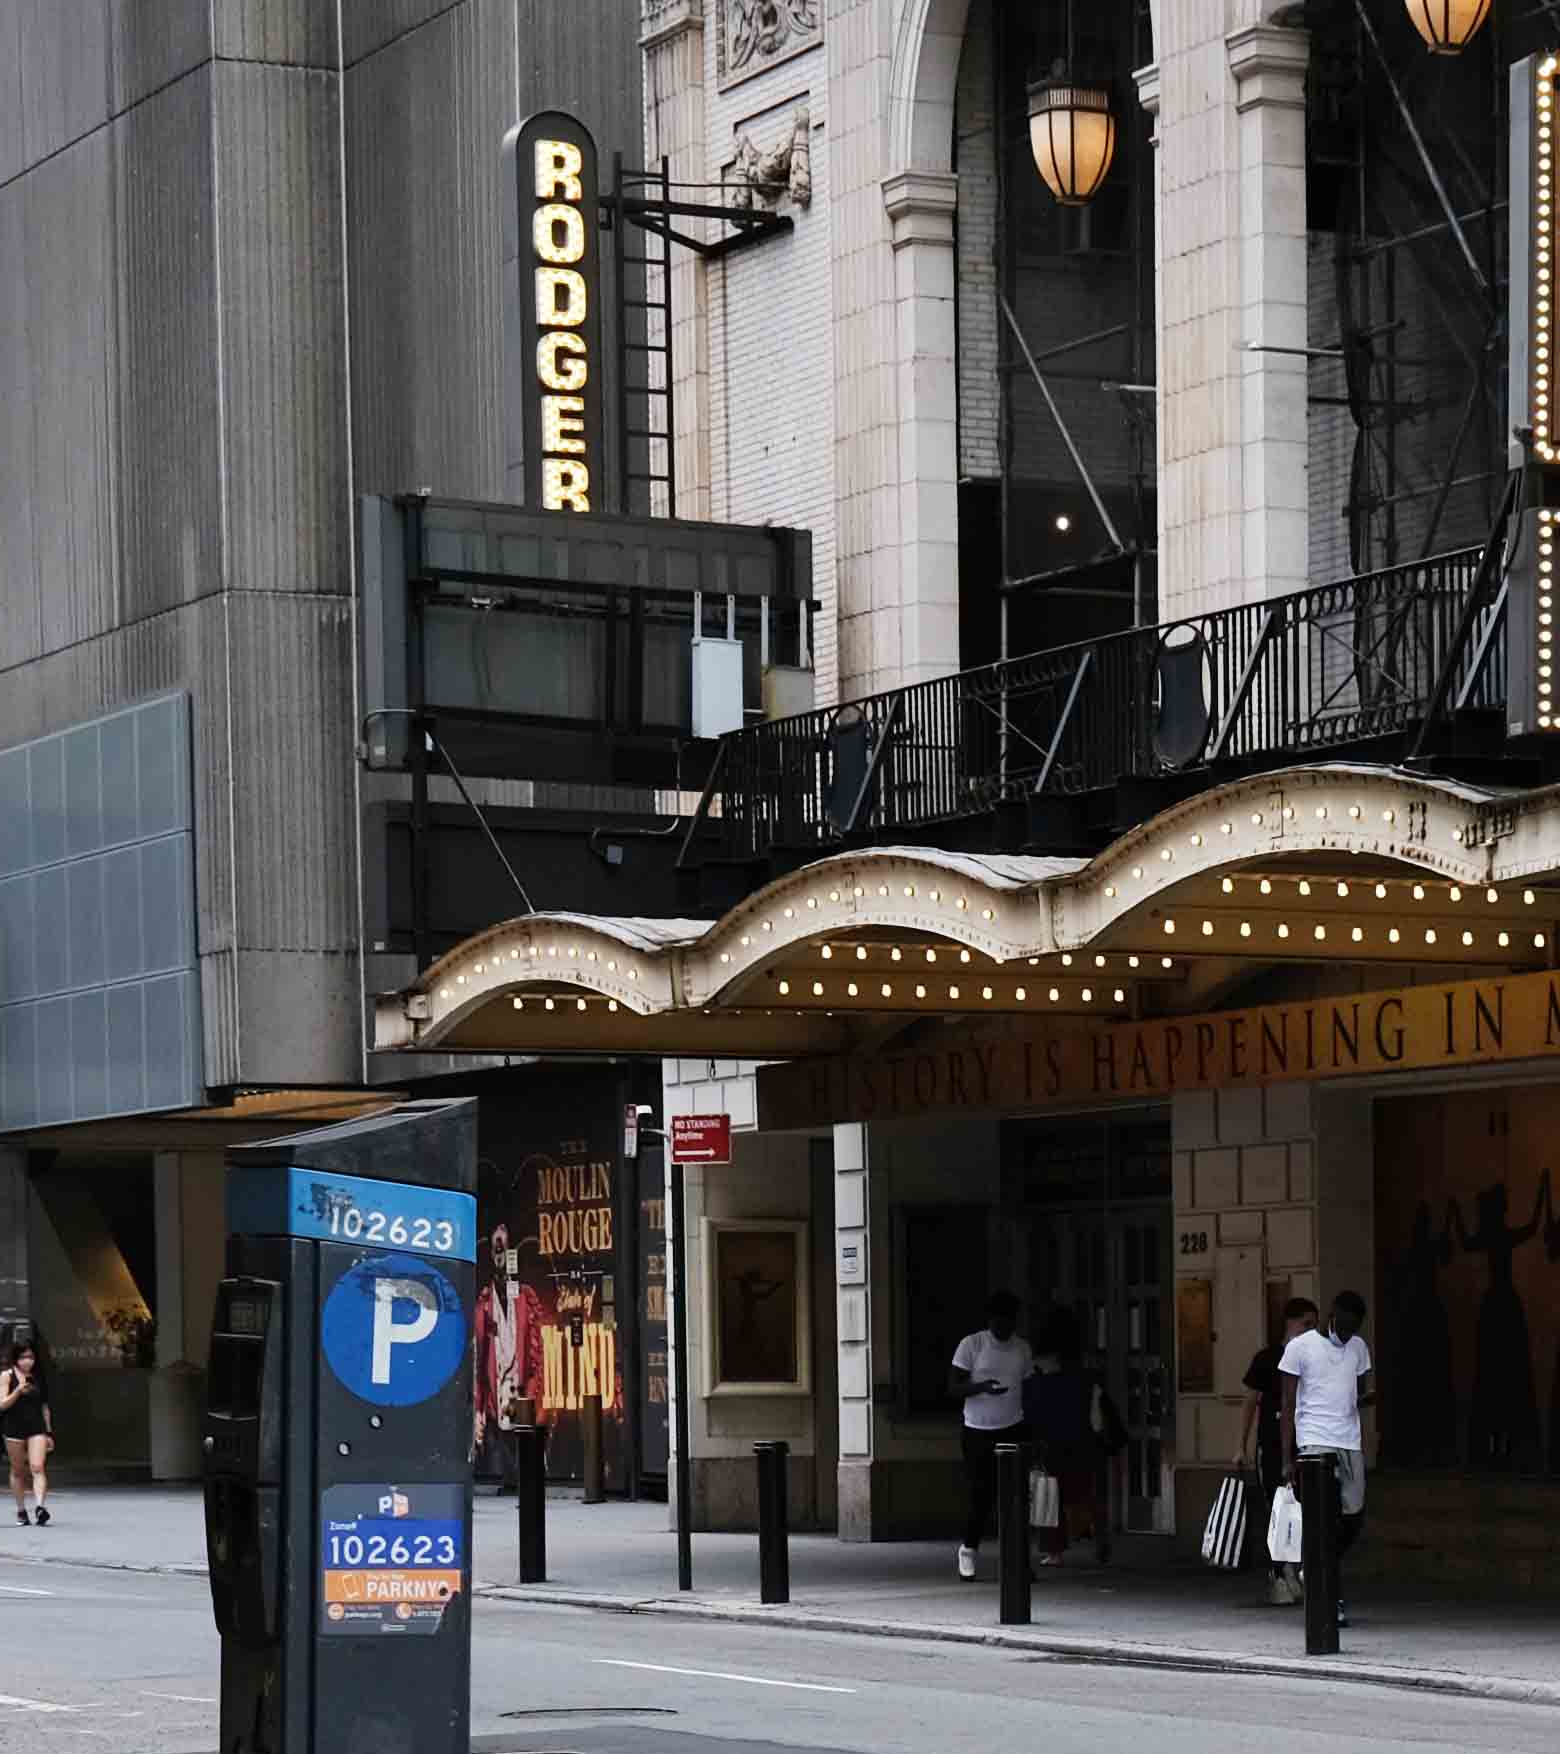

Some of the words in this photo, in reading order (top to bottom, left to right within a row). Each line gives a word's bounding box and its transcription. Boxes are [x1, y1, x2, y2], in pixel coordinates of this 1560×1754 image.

[809, 1040, 998, 1116] HISTORY
[1023, 1038, 1061, 1098] IS
[1091, 998, 1407, 1092] HAPPENING
[1442, 984, 1506, 1055] IN
[686, 1120, 721, 1129] STANDING
[537, 1161, 612, 1206] MOULIN
[331, 1206, 454, 1251] 102623
[538, 1207, 614, 1256] ROUGE
[372, 1277, 439, 1385] P
[541, 1322, 618, 1411] MIND
[330, 1535, 456, 1565] 102623
